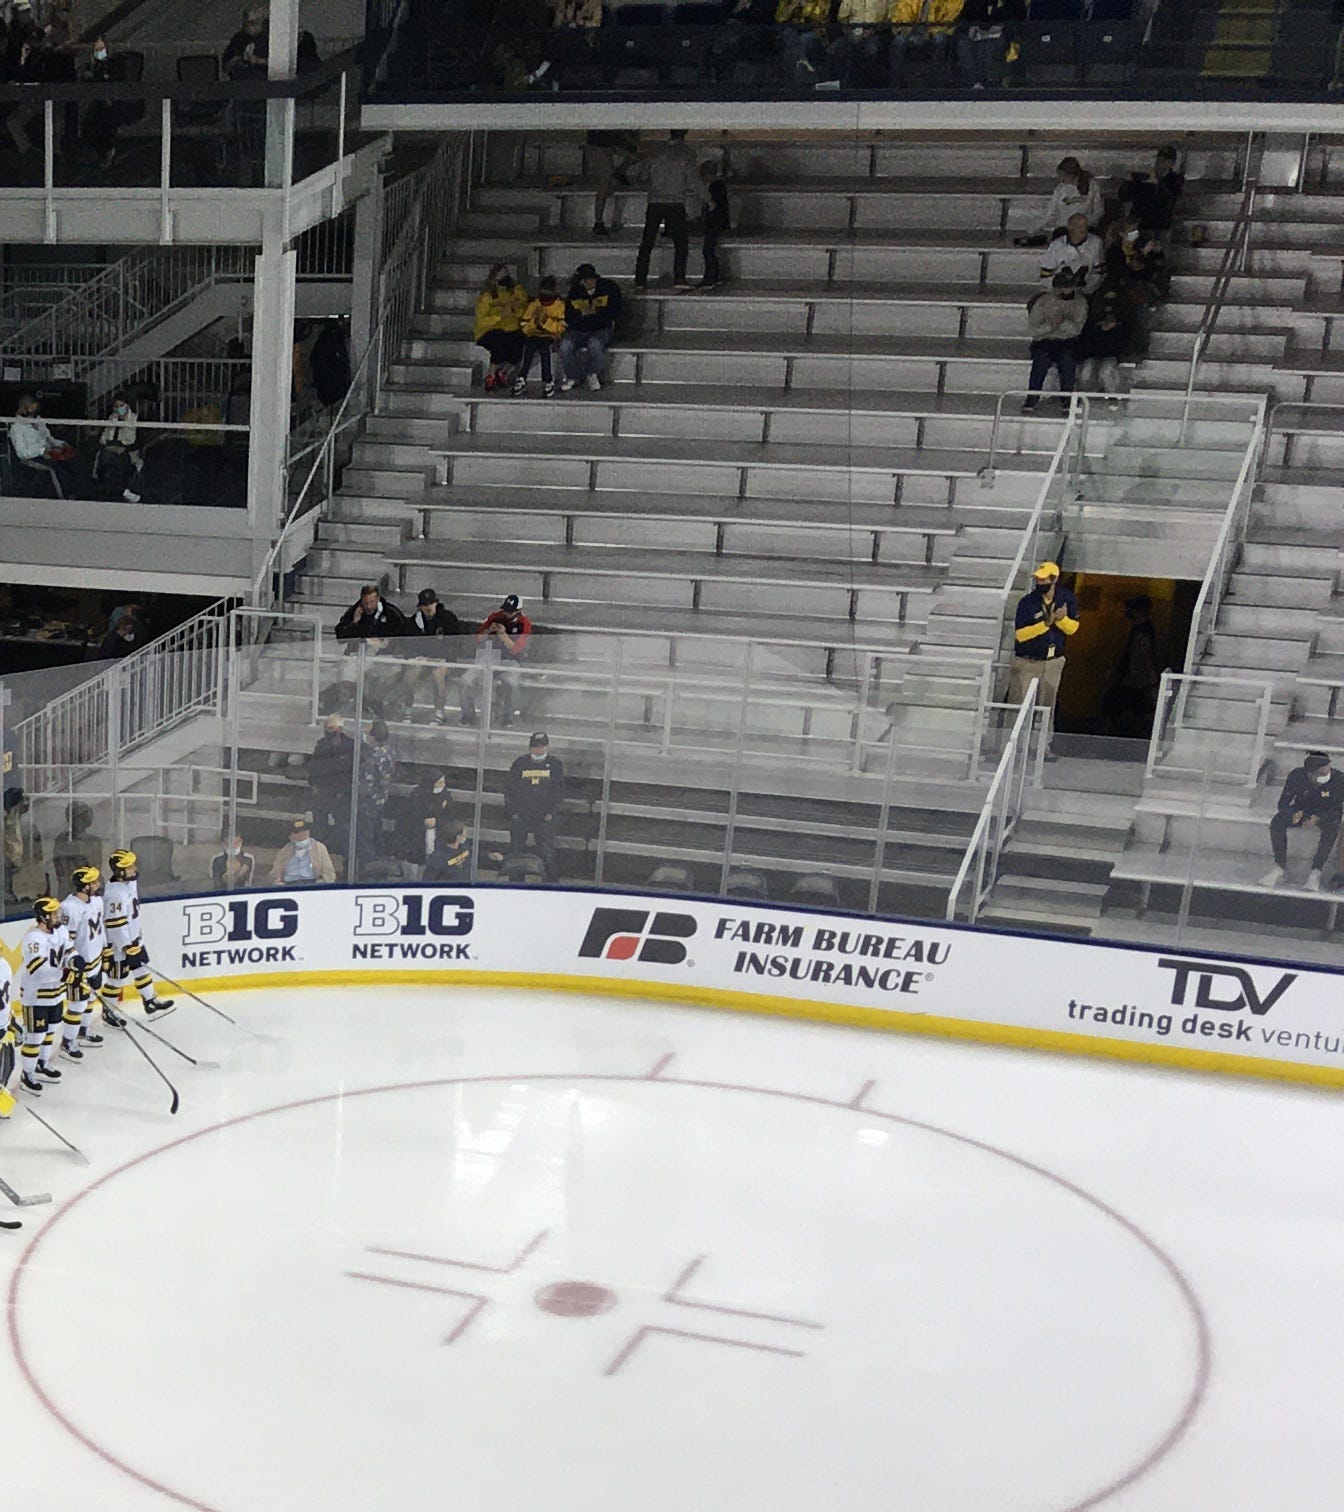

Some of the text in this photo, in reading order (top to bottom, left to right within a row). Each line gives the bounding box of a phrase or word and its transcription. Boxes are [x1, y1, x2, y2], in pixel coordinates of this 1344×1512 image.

[109, 902, 122, 914] 34
[88, 912, 102, 941] M
[352, 943, 471, 960] NETWORK
[714, 918, 952, 966] FARM BUREAU
[50, 945, 65, 968] M
[181, 945, 298, 968] NETWORK
[1157, 957, 1298, 1017] TDV
[1067, 999, 1344, 1054] trading desk ventu
